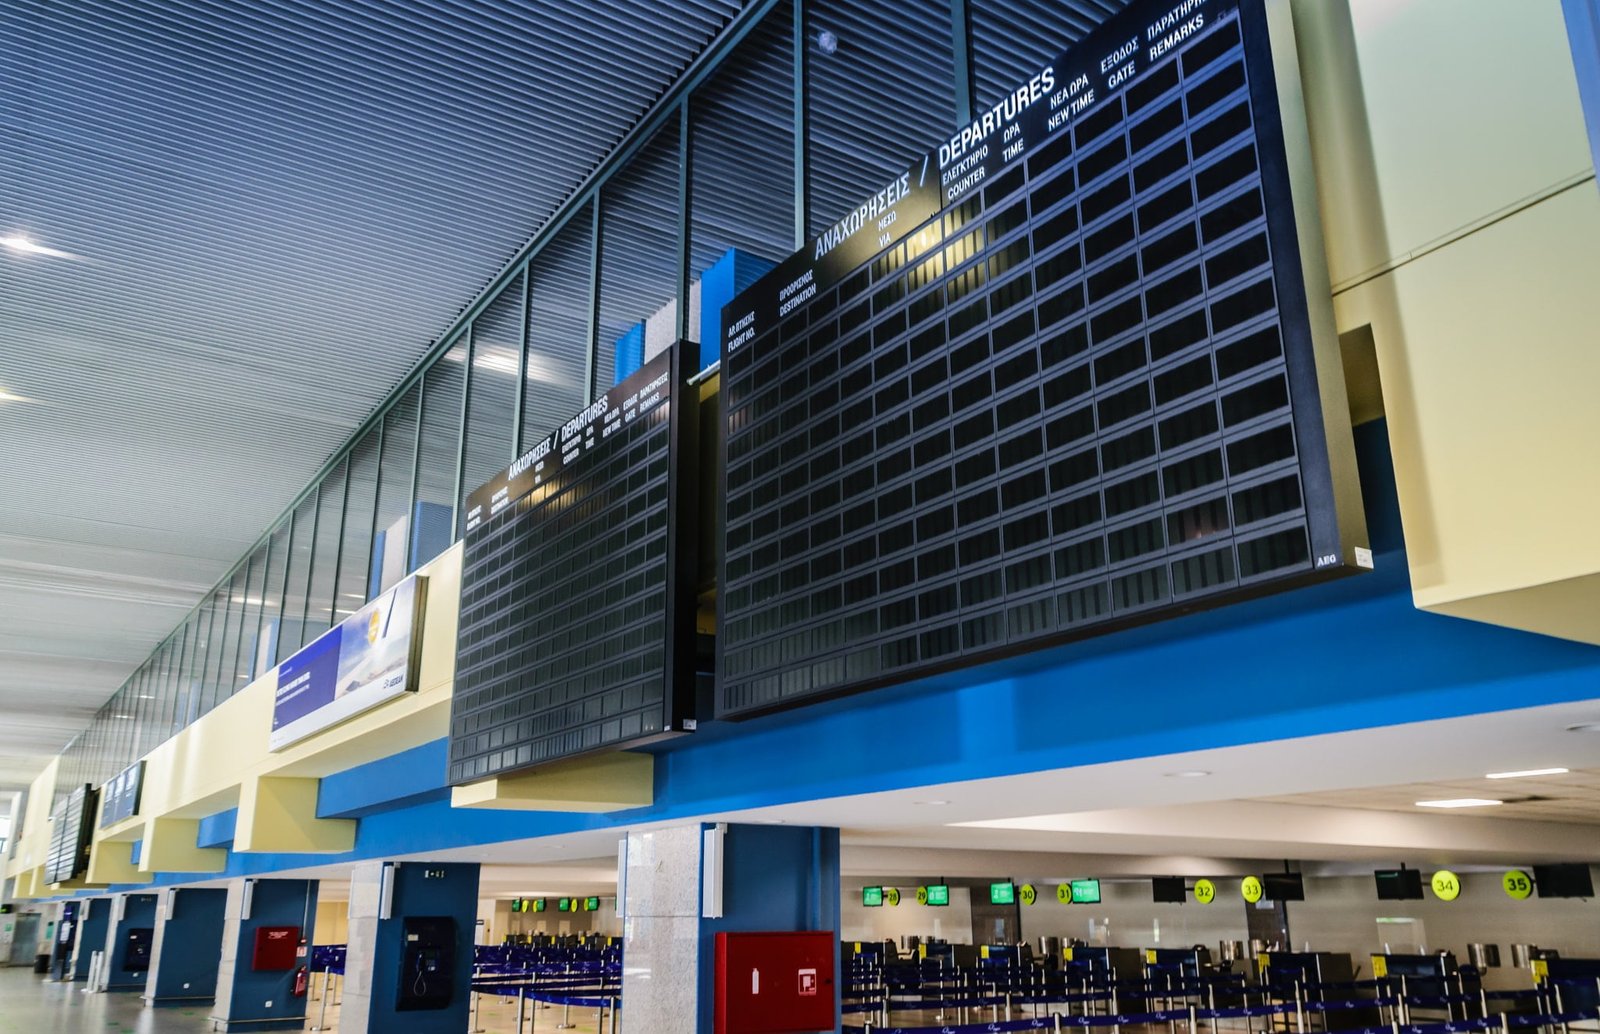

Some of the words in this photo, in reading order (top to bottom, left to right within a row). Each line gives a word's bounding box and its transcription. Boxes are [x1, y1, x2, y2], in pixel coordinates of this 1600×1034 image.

[1149, 13, 1204, 61] REMARKS
[1100, 36, 1139, 75] ΕΞΟΔΟΣ
[1108, 61, 1136, 90] GATE
[1050, 88, 1069, 111] ΝΕΑ
[1069, 73, 1090, 97] ΩΡΑ
[1048, 107, 1071, 132] NEW
[1070, 89, 1095, 119] TIME
[1003, 122, 1021, 143] ΩΡΑ
[1002, 140, 1024, 162] TIME
[815, 171, 910, 261] ΑΝΑΧΩΡΗΣΕΙΣ
[940, 66, 1055, 170] DEPARTURES
[942, 144, 989, 186] ΕΛΕΓΚΤΗΡΙΟ
[947, 167, 985, 199] COUNTER
[878, 210, 897, 231] ΜΕΣΩ
[879, 232, 891, 247] VIA
[779, 283, 817, 317] DESTINATION
[728, 332, 747, 353] FLIGHT
[561, 395, 608, 442] DEPARTURES
[1317, 554, 1337, 567] AEG
[918, 889, 926, 898] 29
[1023, 890, 1033, 899] 30
[1060, 889, 1070, 899] 31
[1197, 886, 1211, 897] 32
[1245, 885, 1259, 895] 33
[1436, 880, 1453, 892] 34
[1507, 878, 1527, 891] 35
